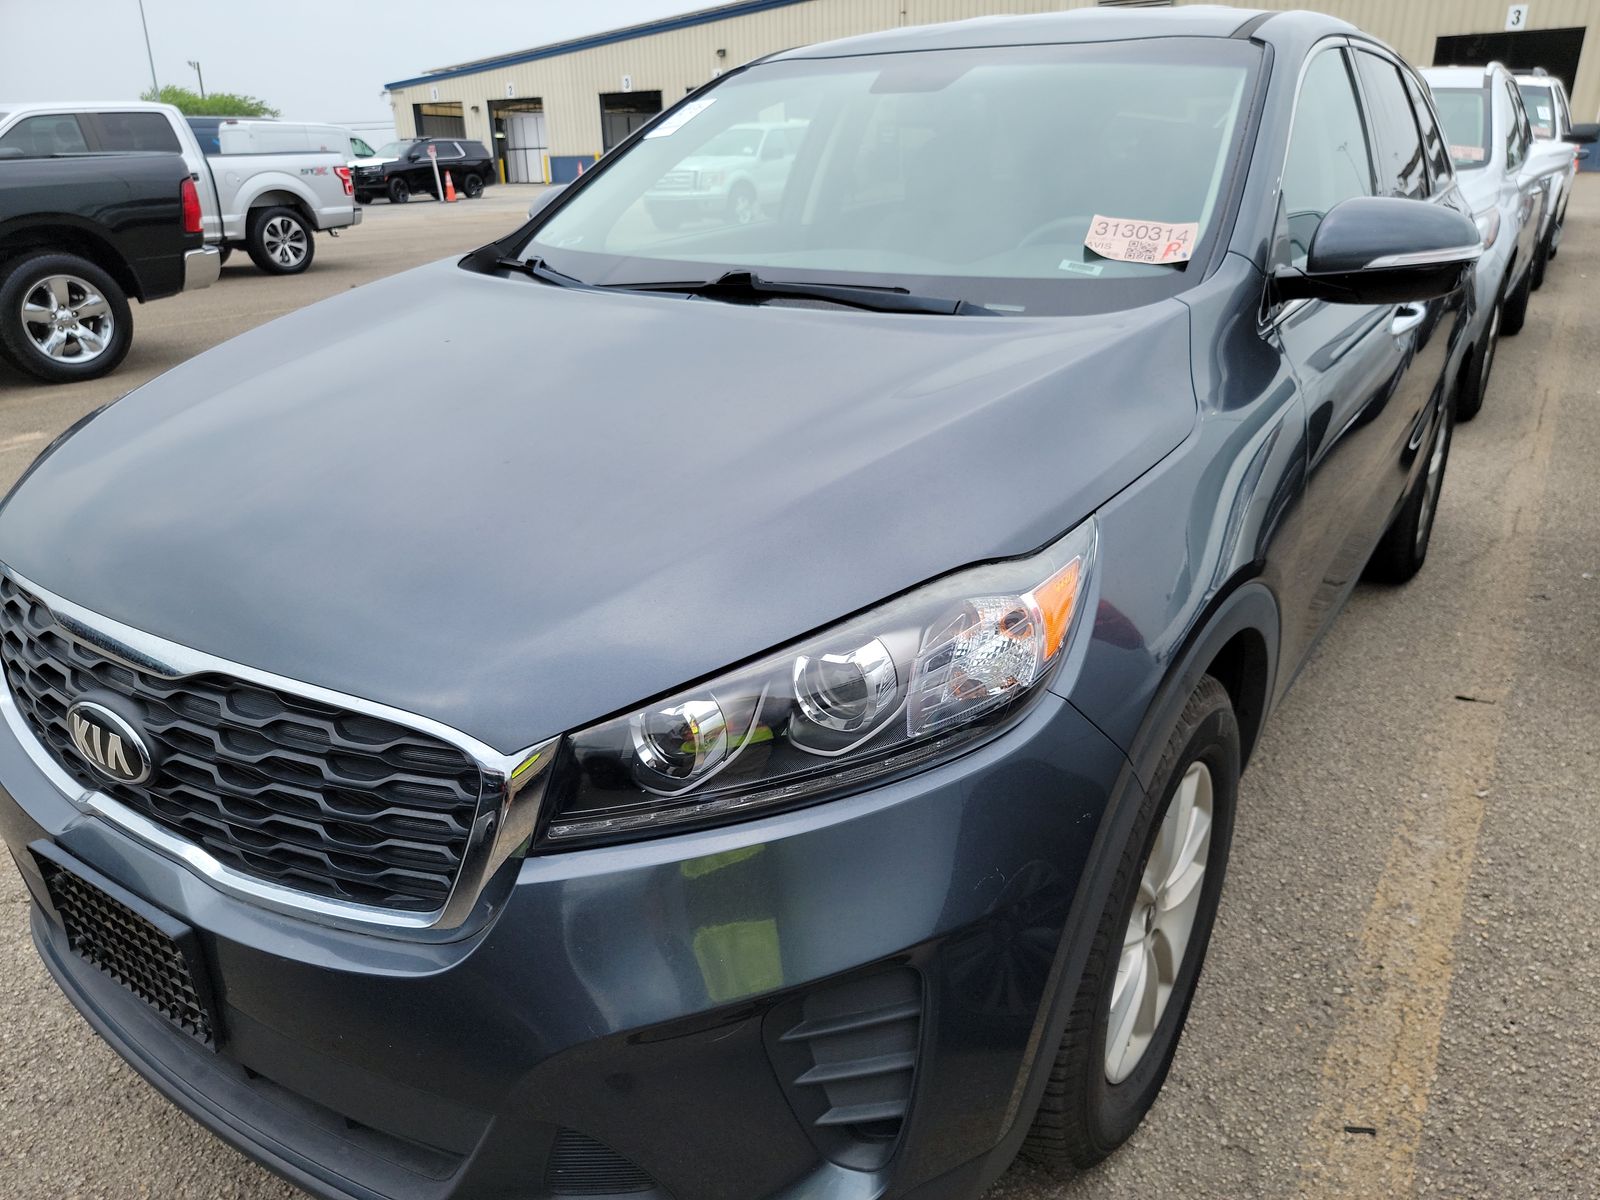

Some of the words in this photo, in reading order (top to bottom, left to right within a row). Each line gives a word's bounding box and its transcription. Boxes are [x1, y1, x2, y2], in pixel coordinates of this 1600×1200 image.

[1511, 9, 1521, 26] 3
[1095, 221, 1189, 243] 3130314
[73, 712, 134, 776] KIA
